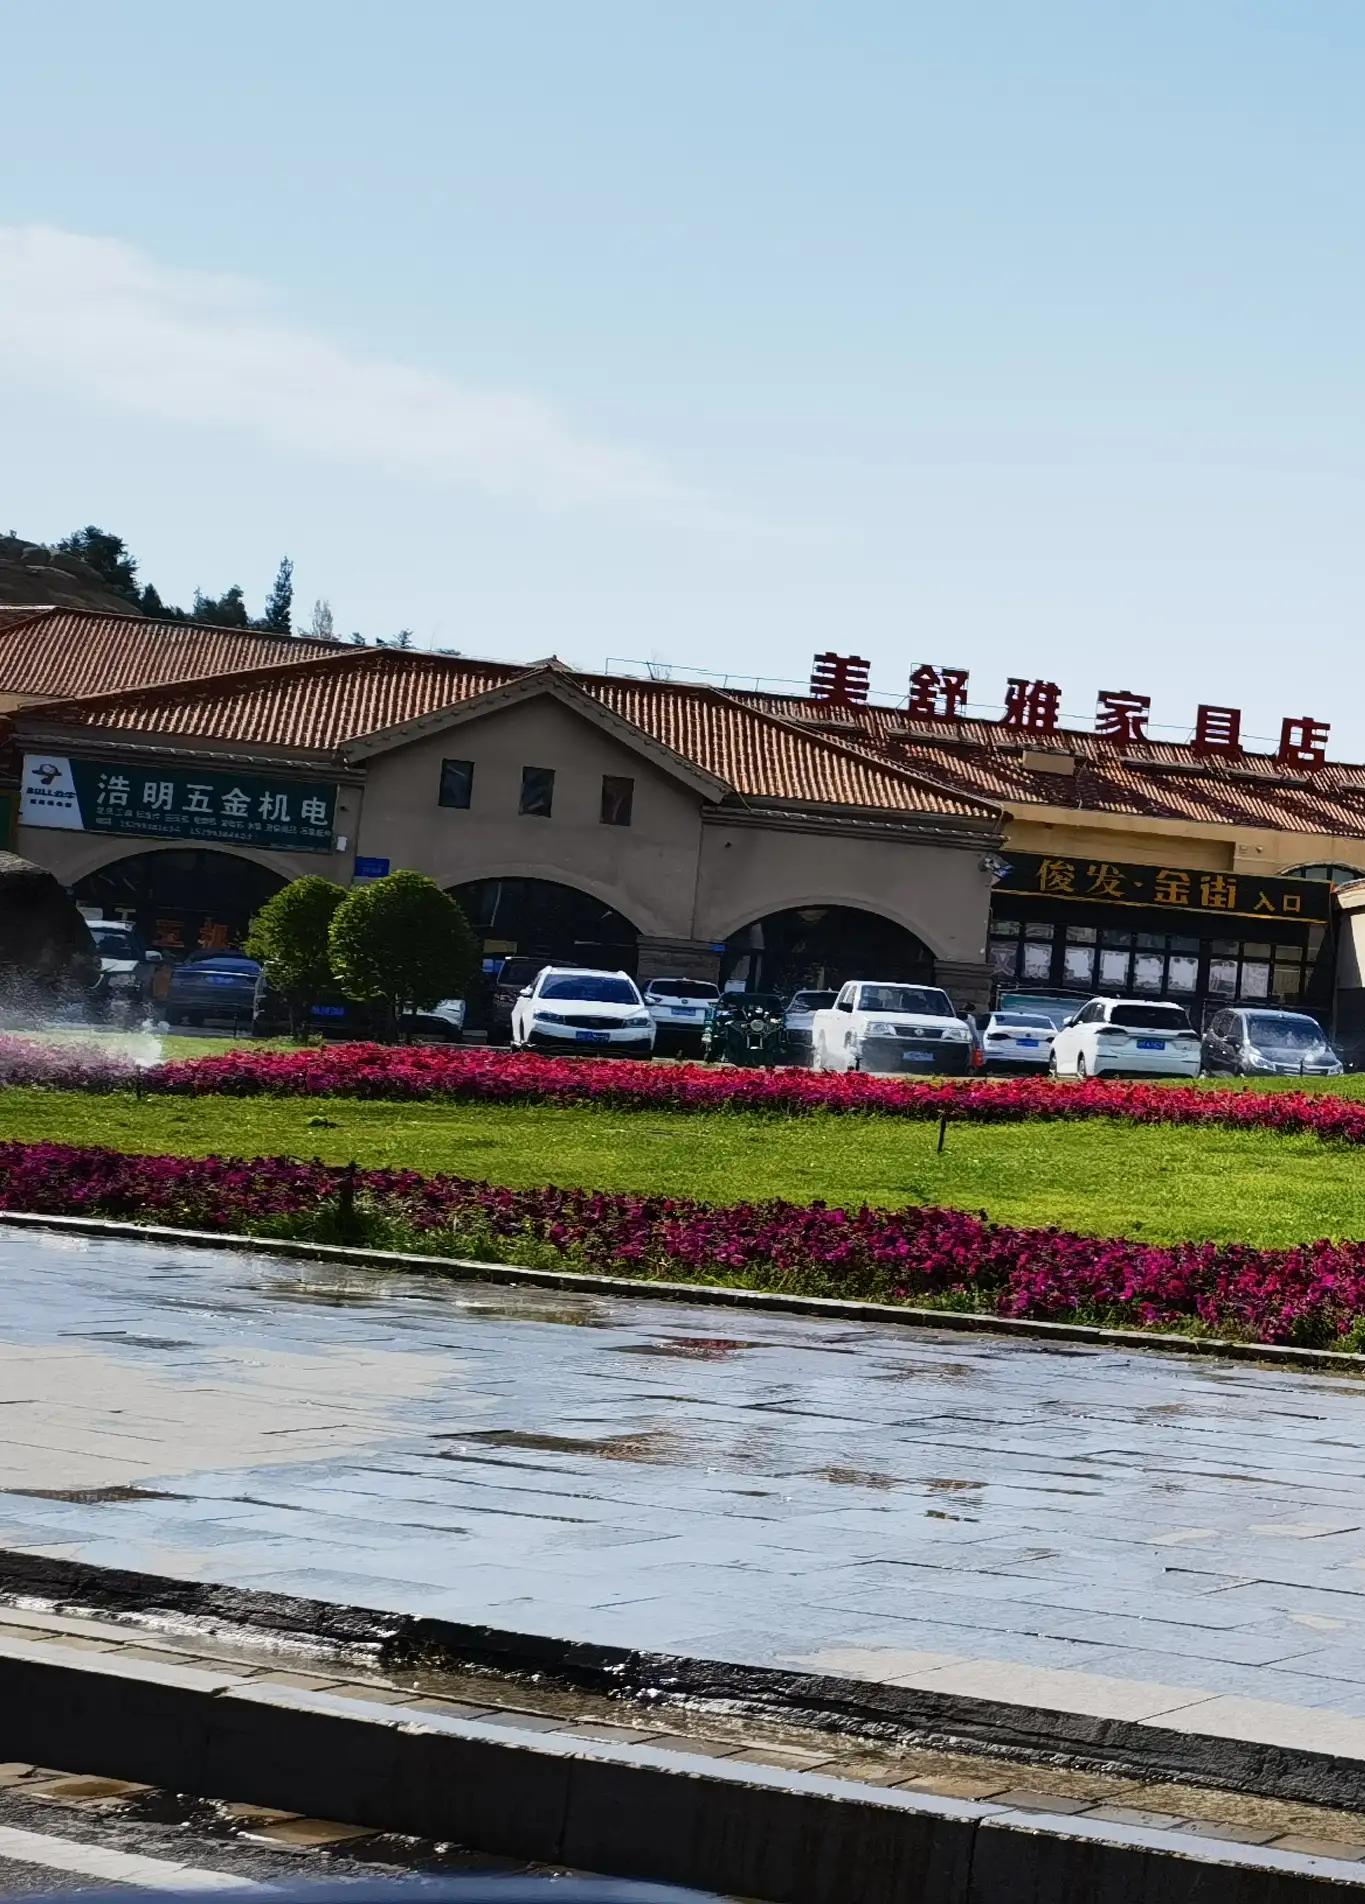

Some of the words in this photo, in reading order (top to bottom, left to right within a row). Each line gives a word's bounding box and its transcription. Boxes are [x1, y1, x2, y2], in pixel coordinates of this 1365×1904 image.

[810, 652, 1332, 768] 美舒雅家具店
[96, 773, 329, 826] 浩明五金机电
[1253, 891, 1302, 913] 入口
